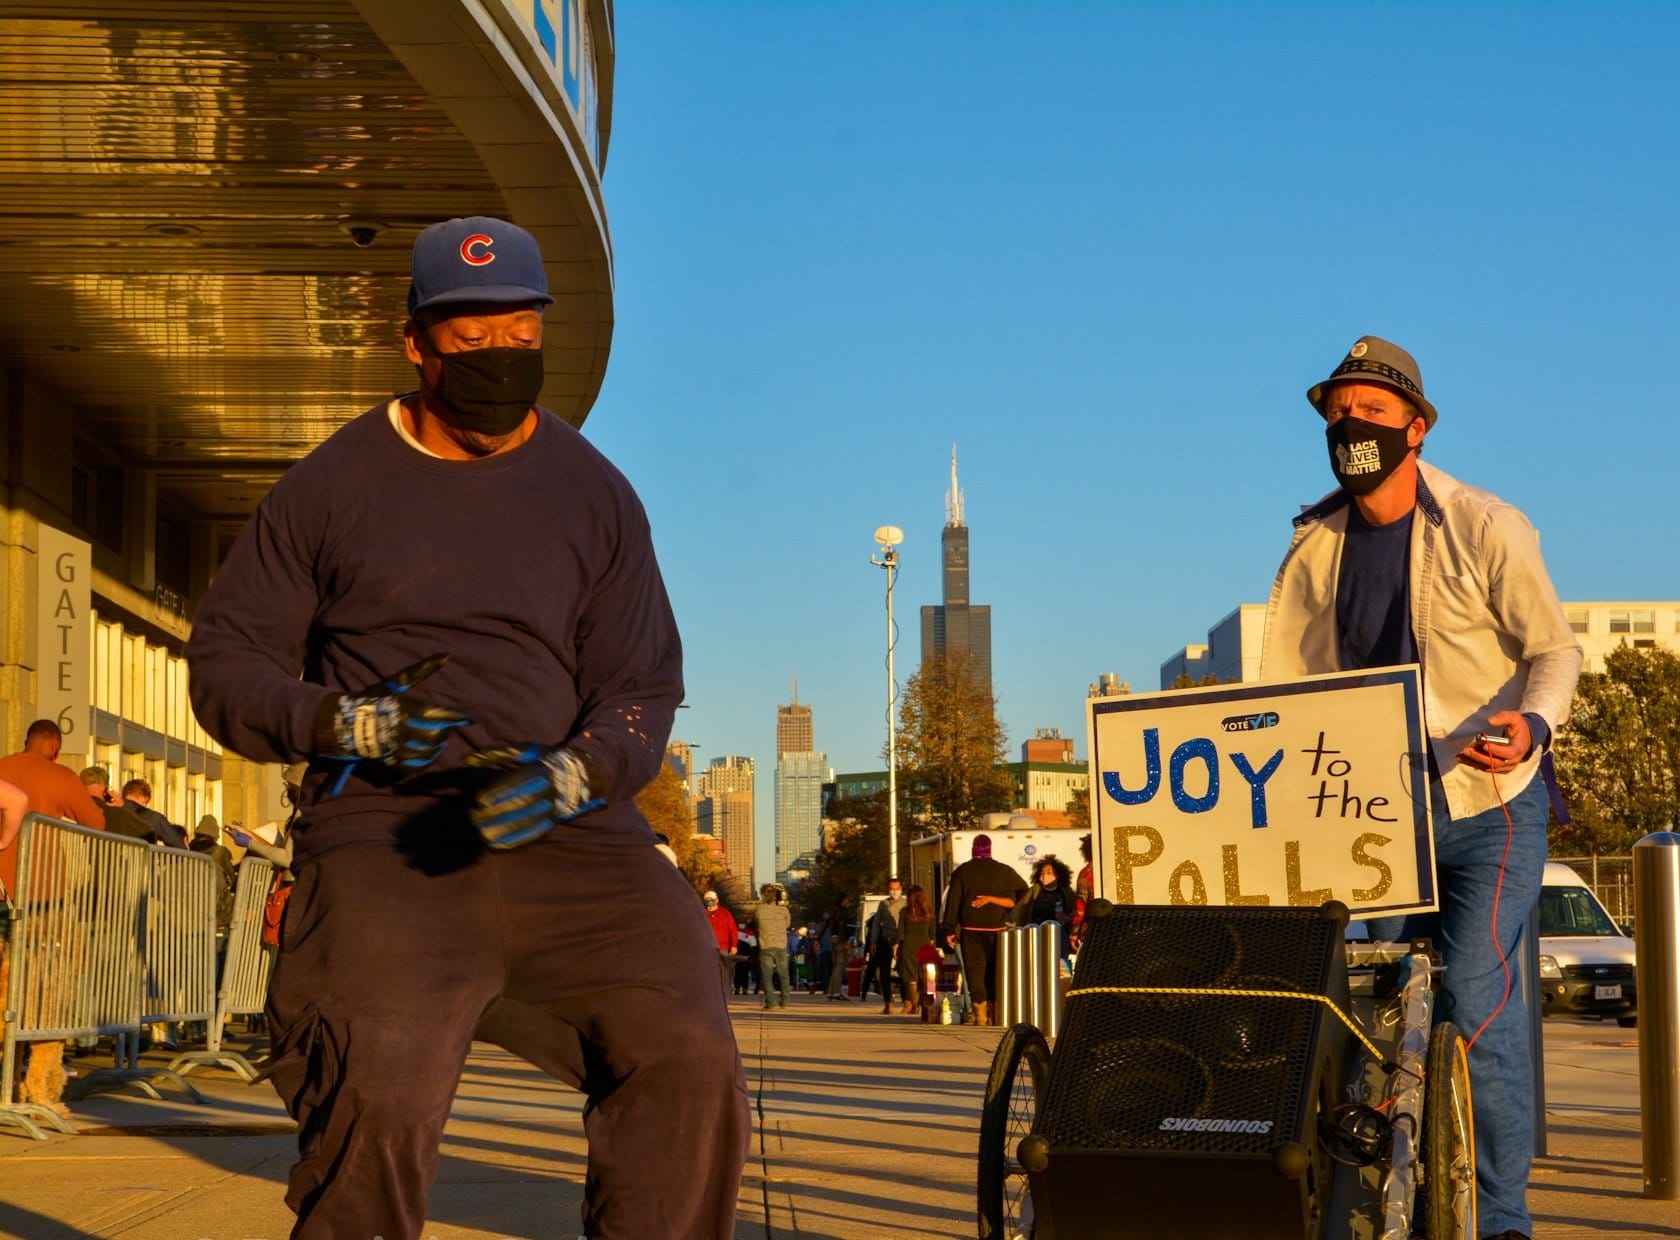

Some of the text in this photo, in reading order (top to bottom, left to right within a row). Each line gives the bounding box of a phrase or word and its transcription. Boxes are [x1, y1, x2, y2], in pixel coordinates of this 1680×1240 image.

[459, 233, 496, 267] C
[1349, 439, 1378, 452] LACK
[1345, 462, 1382, 476] MATTER
[54, 552, 76, 736] GATE 6
[1221, 720, 1249, 731] VOTE
[1102, 727, 1352, 829] JOY to
[1307, 780, 1398, 822] the
[1113, 825, 1393, 907] POLLS
[1159, 1117, 1274, 1134] SOUNDBOKS
